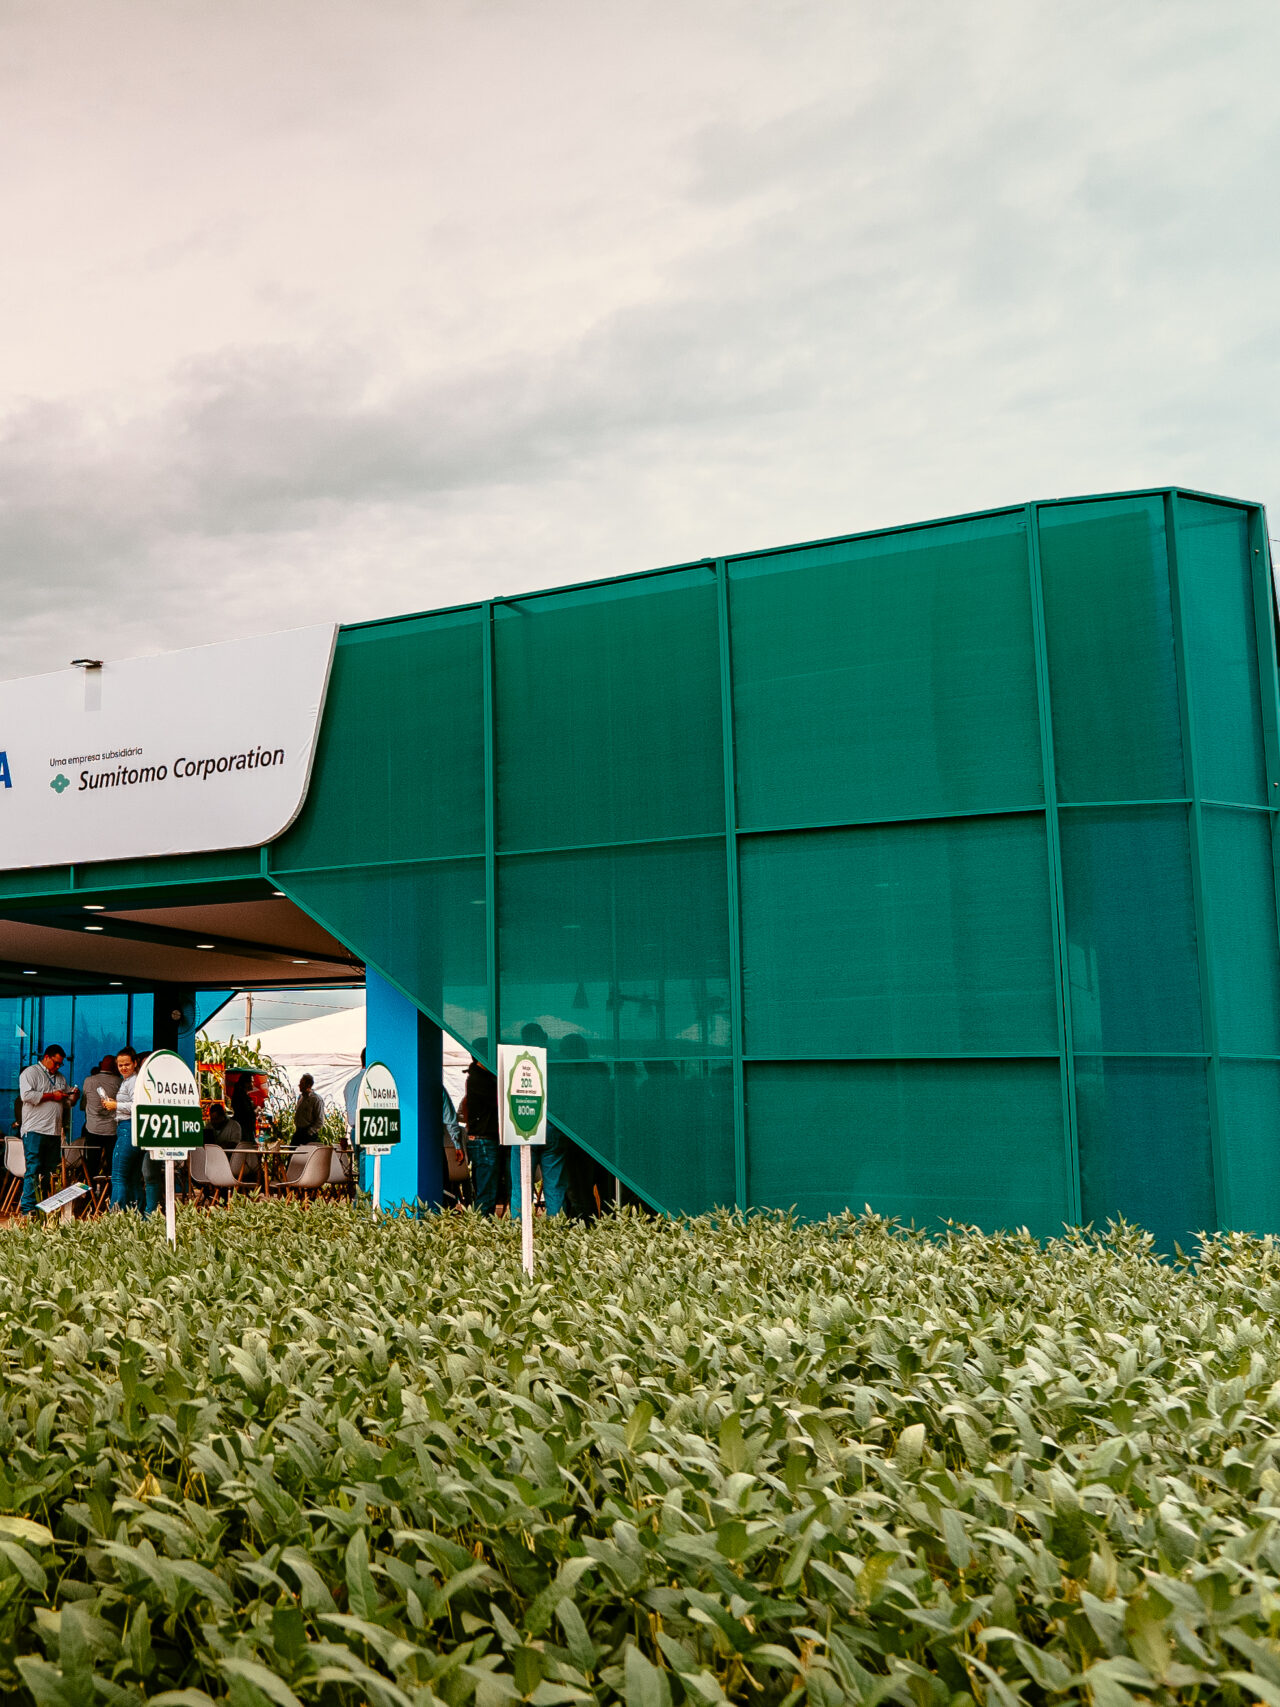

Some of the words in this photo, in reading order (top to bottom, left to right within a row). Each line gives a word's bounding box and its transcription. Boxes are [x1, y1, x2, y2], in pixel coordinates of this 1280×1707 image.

[49, 757, 67, 767] Uma
[67, 753, 101, 766] empresa
[101, 747, 143, 760] subsidiária
[78, 764, 168, 791] Sumitomo
[173, 746, 285, 780] Corporation
[157, 1081, 195, 1096] DAGMA
[372, 1088, 397, 1100] DAGMA
[139, 1114, 180, 1138] 7921
[182, 1121, 201, 1133] IPRO
[362, 1116, 389, 1137] 7621
